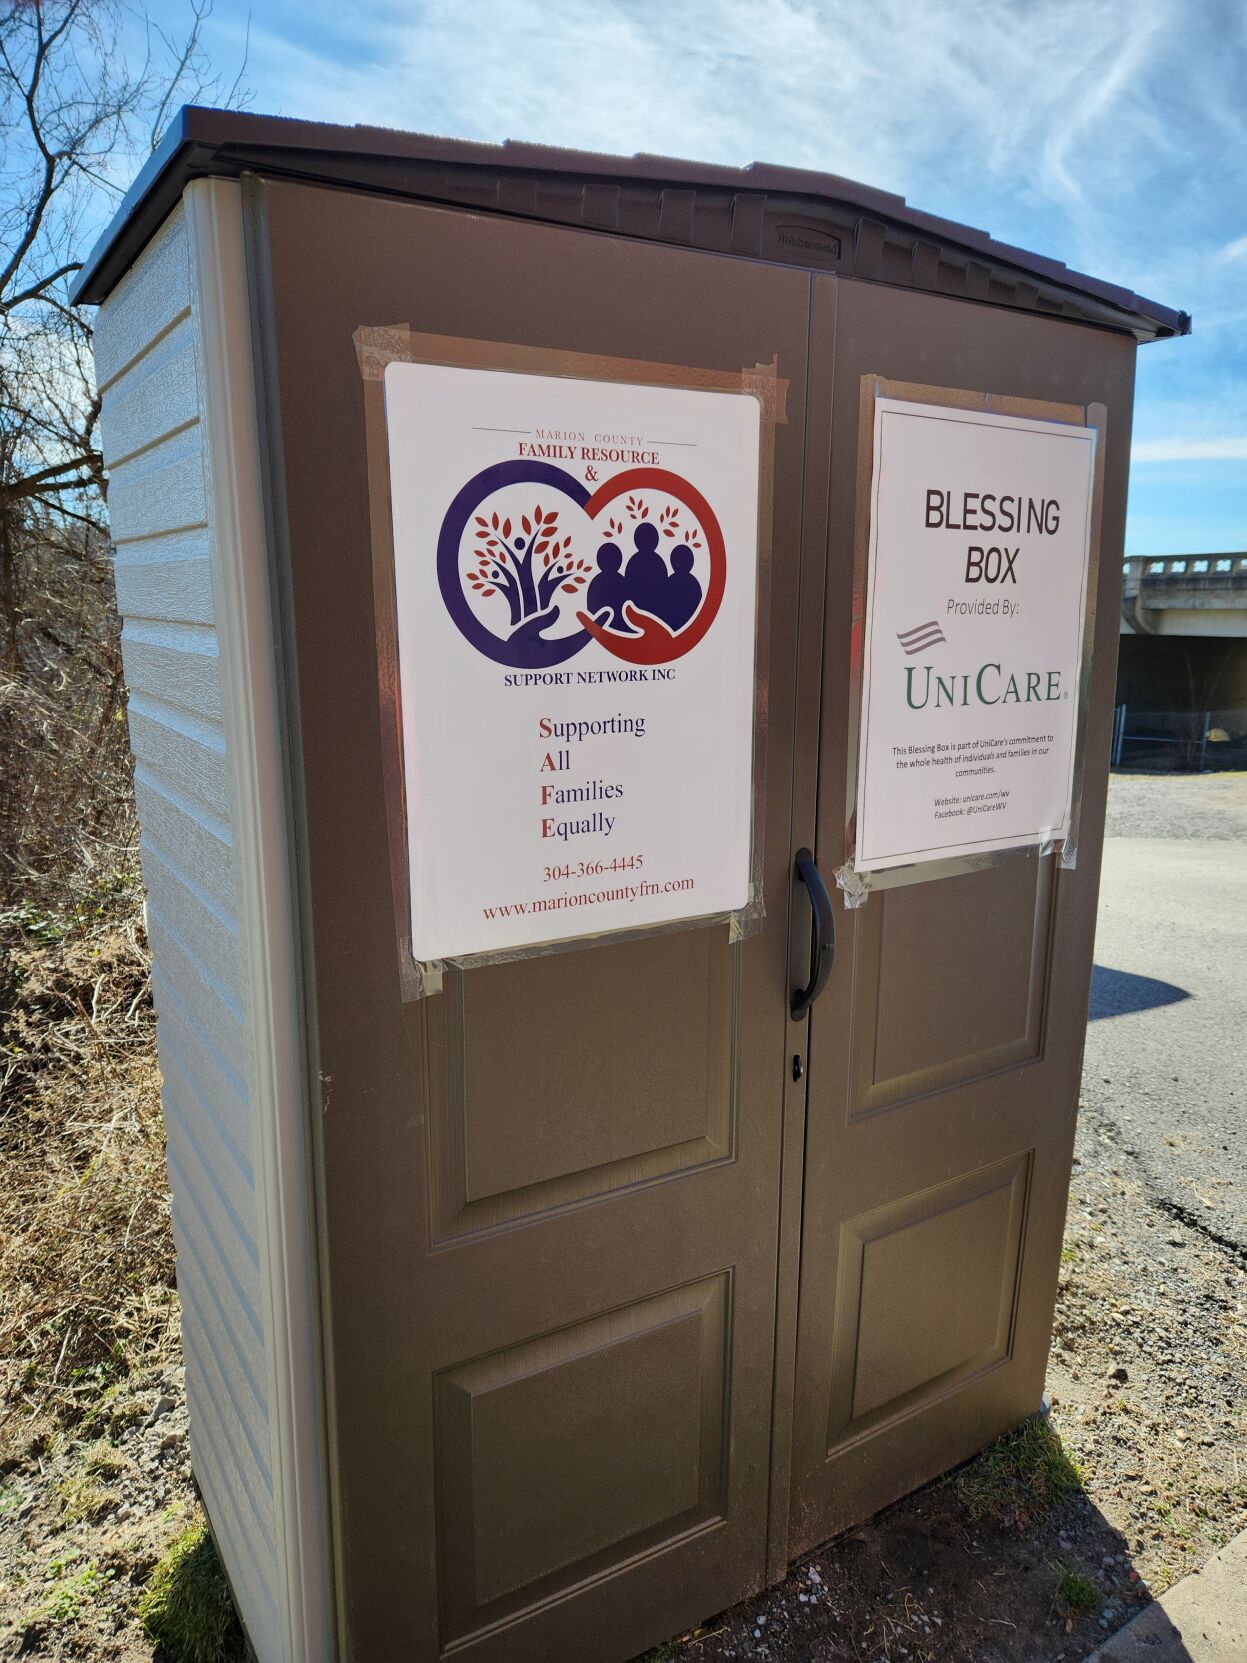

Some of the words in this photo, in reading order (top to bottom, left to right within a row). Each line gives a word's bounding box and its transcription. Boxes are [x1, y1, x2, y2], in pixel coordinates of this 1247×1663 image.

[535, 430, 585, 441] MARION
[594, 434, 643, 445] COUNTY
[518, 442, 577, 459] FAMILY
[581, 448, 660, 465] RESOURCE
[585, 466, 598, 481] &
[925, 490, 1060, 535] BLESSING
[965, 547, 1020, 583] BOX
[947, 599, 999, 615] Provided
[1002, 600, 1019, 617] By:
[504, 673, 573, 686] SUPPORT
[577, 670, 648, 683] NETWORK
[652, 669, 675, 681] INC
[539, 713, 646, 742] Supporting
[892, 747, 907, 756] This
[908, 745, 935, 755] Blessing
[936, 744, 949, 752] Box
[950, 742, 956, 751] is
[957, 741, 971, 751] part
[972, 740, 979, 749] of
[1009, 735, 1046, 746] commitment
[540, 751, 570, 772] All
[896, 760, 907, 769] the
[910, 758, 930, 767] whole
[932, 756, 952, 766] health
[954, 755, 961, 764] of
[962, 752, 995, 763] individuals
[996, 750, 1006, 759] and
[1007, 748, 1030, 758] families
[1039, 747, 1049, 755] our
[955, 766, 995, 777] communities.
[540, 780, 623, 806] Families
[934, 796, 962, 807] Website:
[962, 790, 1010, 804] unicare.com/wv
[935, 808, 965, 819] Facebook:
[966, 802, 1006, 816] @UniCareWV
[541, 813, 616, 840] Equally
[543, 855, 644, 882] 304-366-4445
[482, 877, 694, 920] www.marioncountyfrn.com
